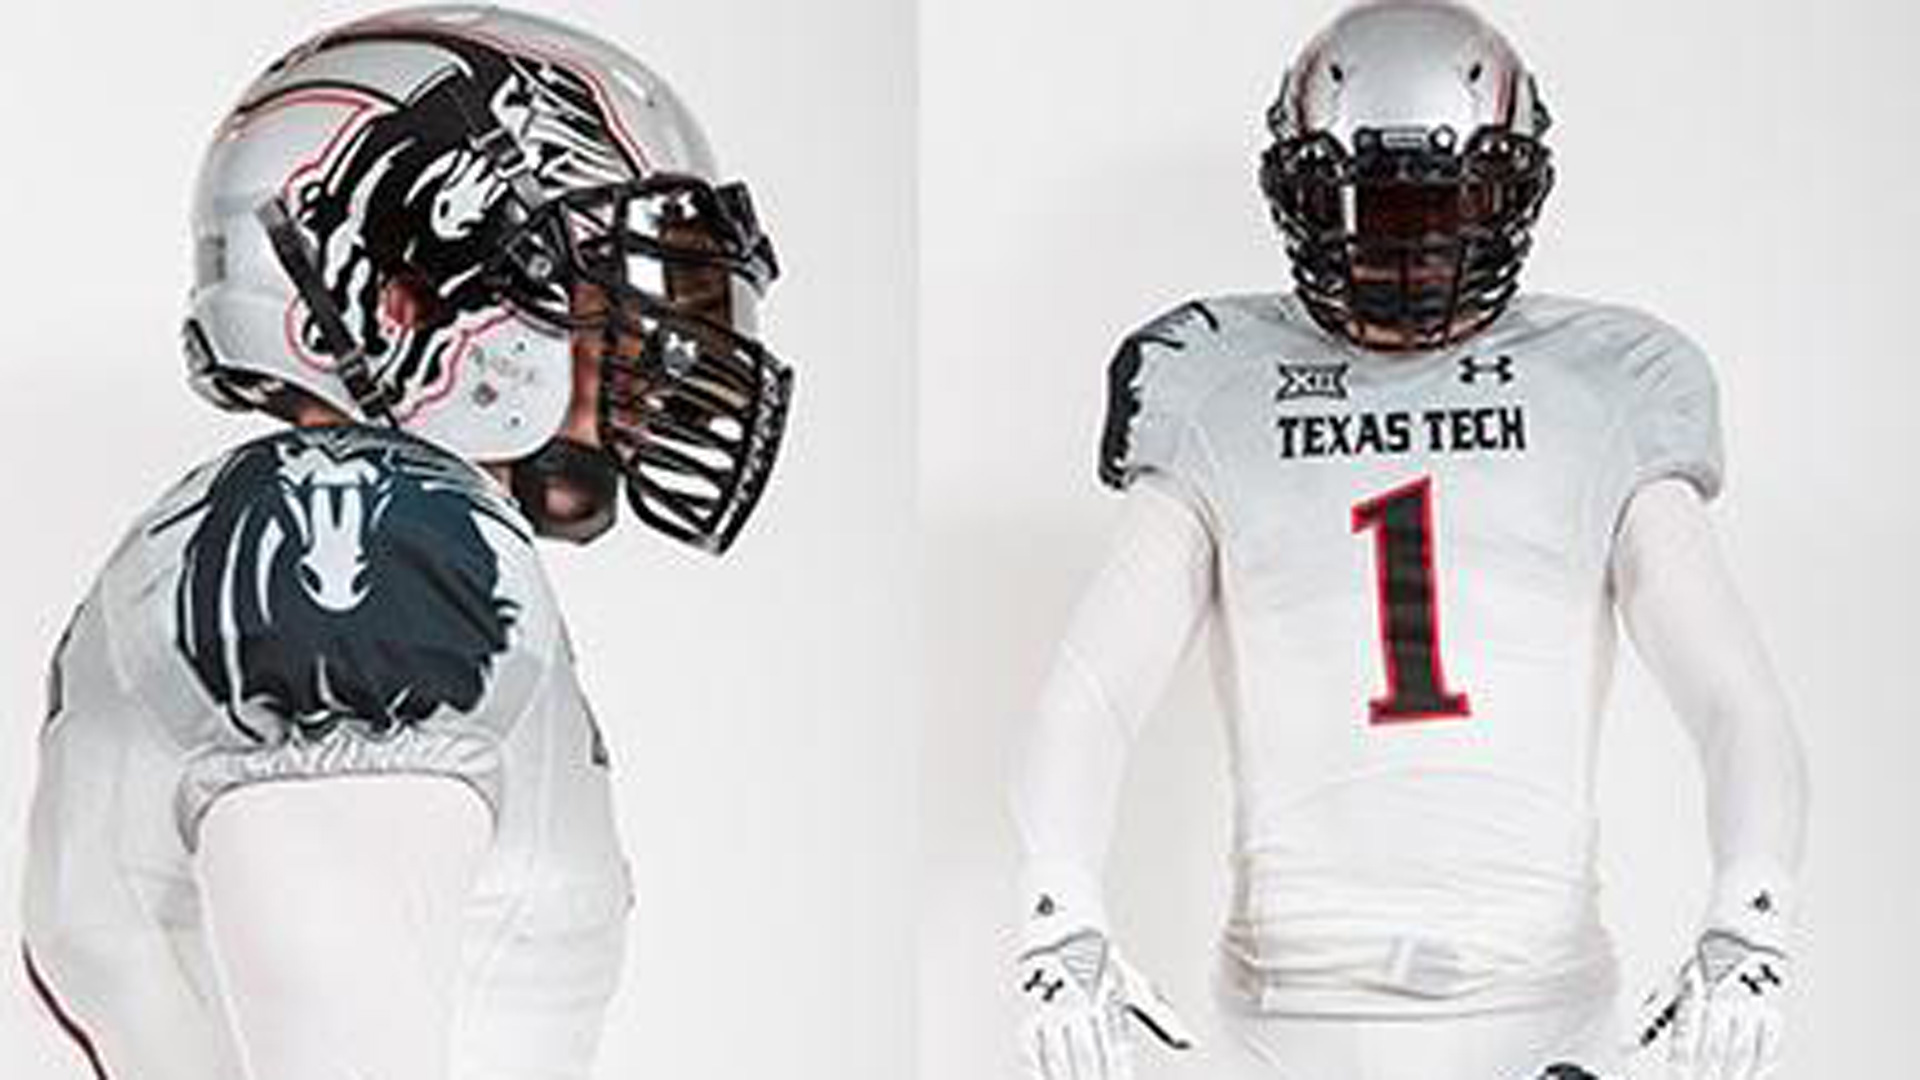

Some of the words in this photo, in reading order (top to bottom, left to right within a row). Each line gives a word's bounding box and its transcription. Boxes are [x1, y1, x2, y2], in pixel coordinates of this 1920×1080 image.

[1277, 412, 1411, 458] TEXAS
[1424, 406, 1526, 451] TECH
[1350, 474, 1471, 725] 1
